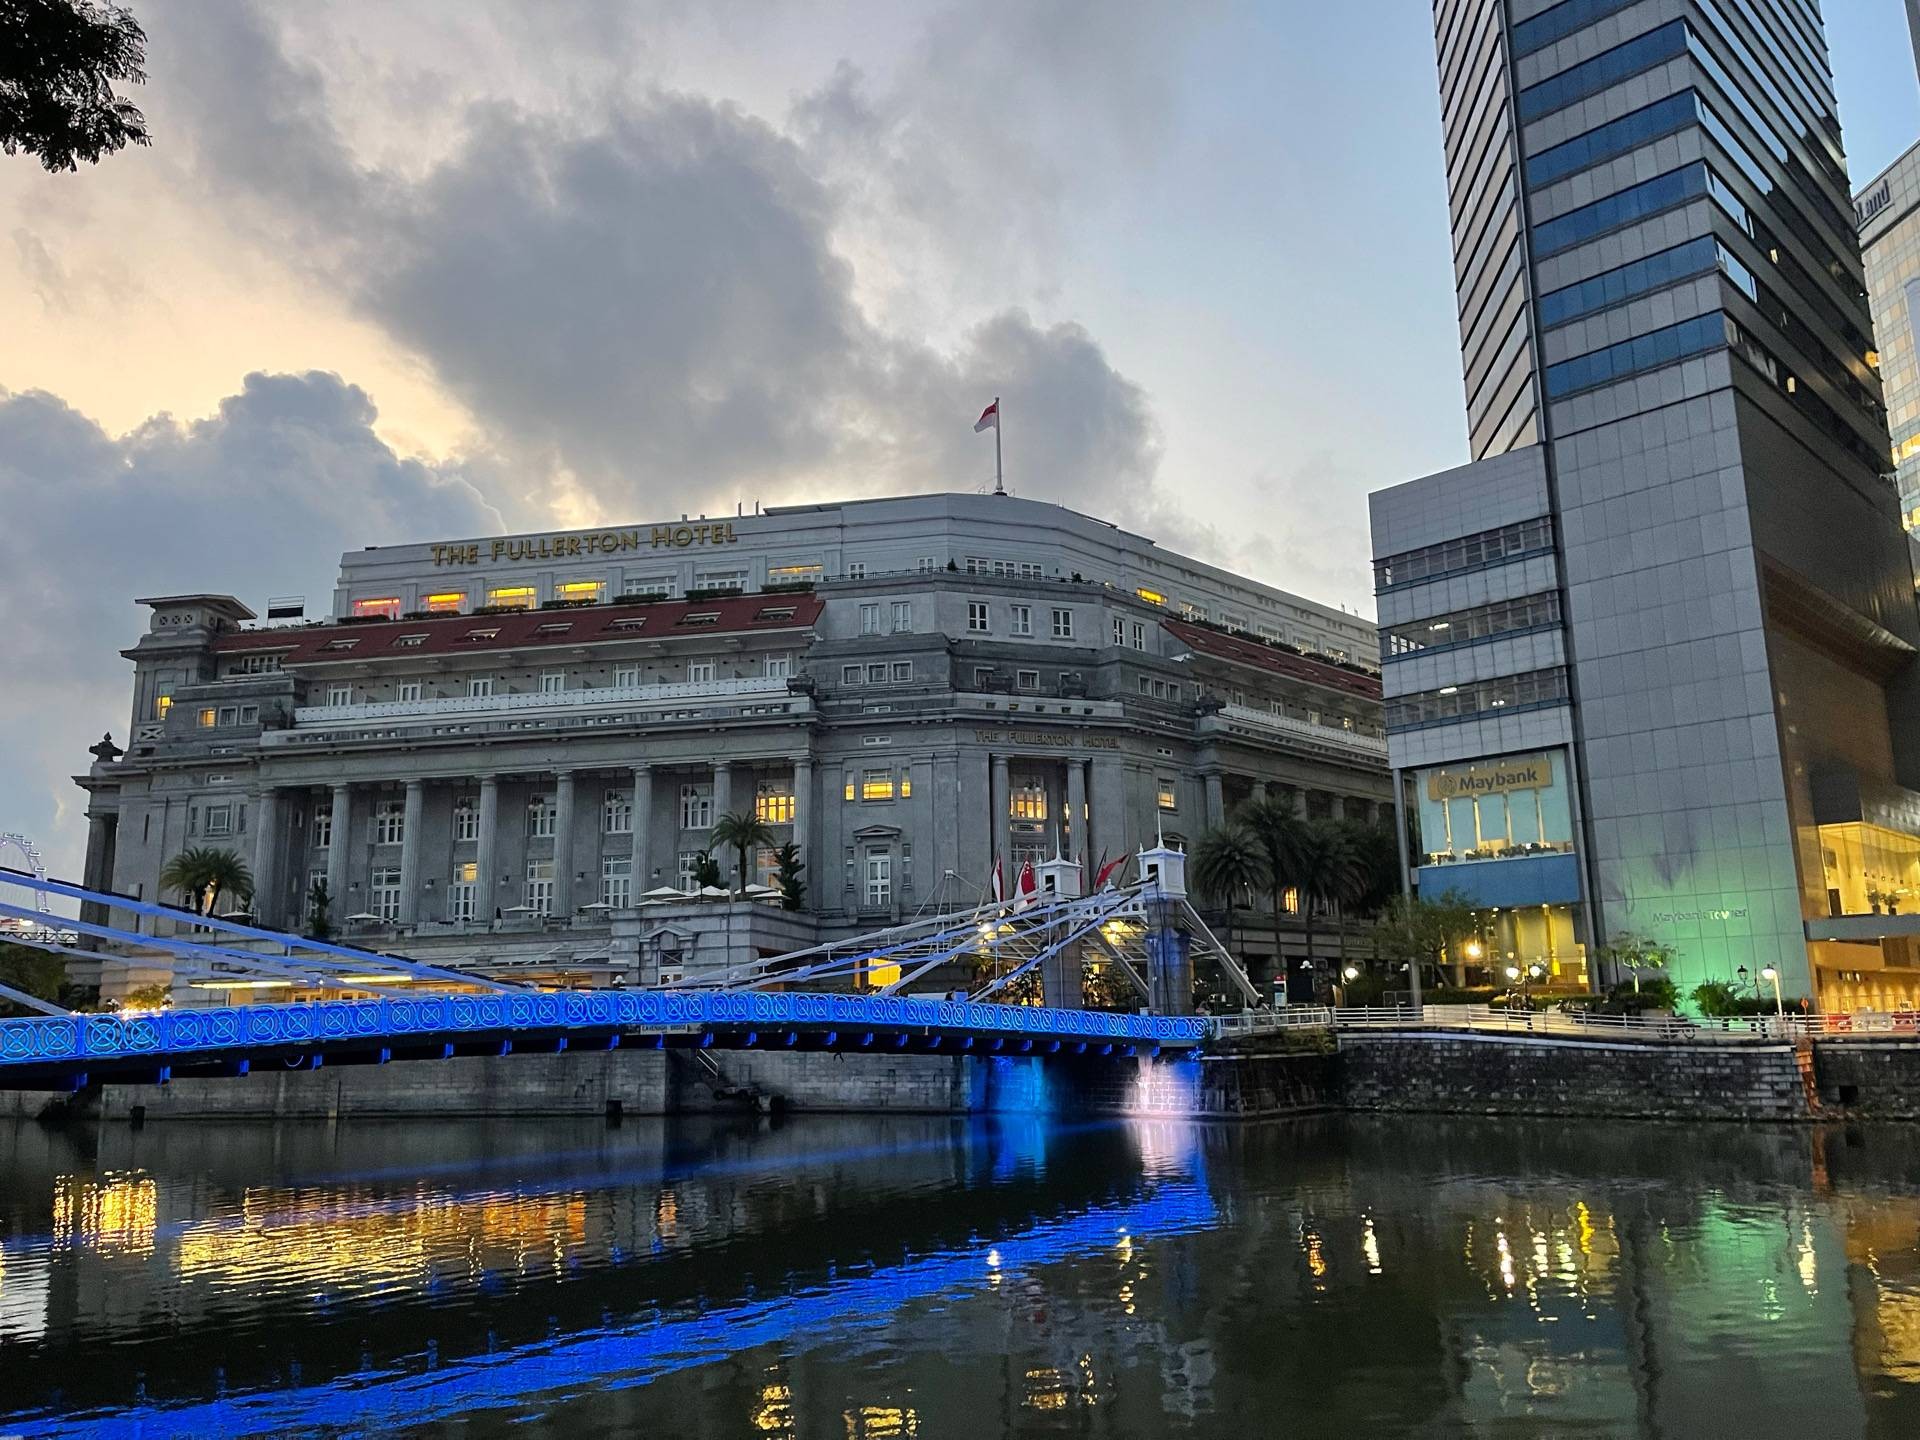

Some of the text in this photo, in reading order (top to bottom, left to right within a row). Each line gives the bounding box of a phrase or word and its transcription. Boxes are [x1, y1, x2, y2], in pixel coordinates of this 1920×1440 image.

[1856, 179, 1890, 225] Land
[431, 523, 737, 567] THE FULLERTON HOTEL
[975, 729, 1120, 748] THE FULLERTON HOTEL
[1460, 768, 1538, 791] Maybank
